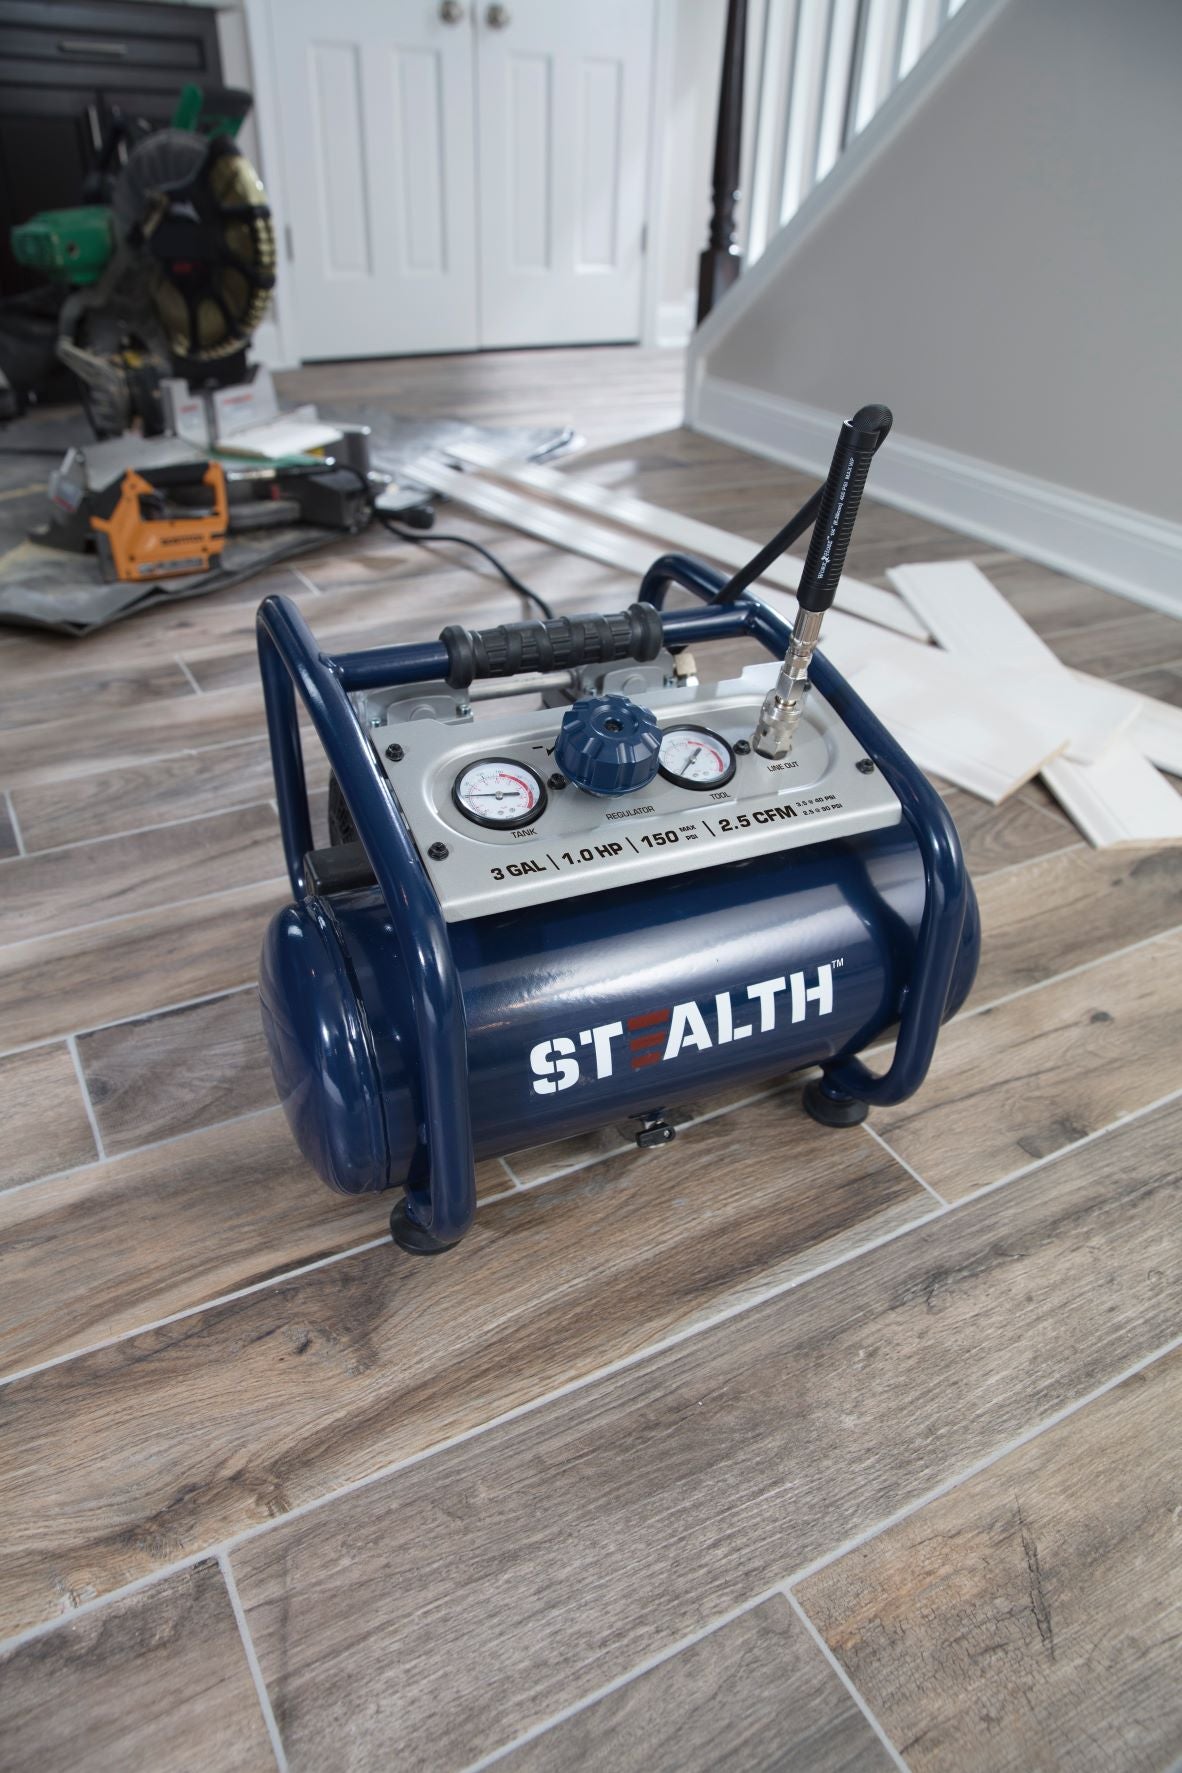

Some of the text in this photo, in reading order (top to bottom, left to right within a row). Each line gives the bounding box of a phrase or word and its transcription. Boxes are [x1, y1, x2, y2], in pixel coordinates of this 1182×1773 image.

[767, 760, 800, 772] LINE OUT
[709, 791, 731, 801] TOOL
[606, 806, 655, 820] REGULATOR
[511, 828, 537, 839] TANK
[678, 824, 697, 833] MAX
[685, 833, 699, 841] PSI
[490, 805, 798, 881] 3 GAL 1.0 HP 150 2.5 CFM
